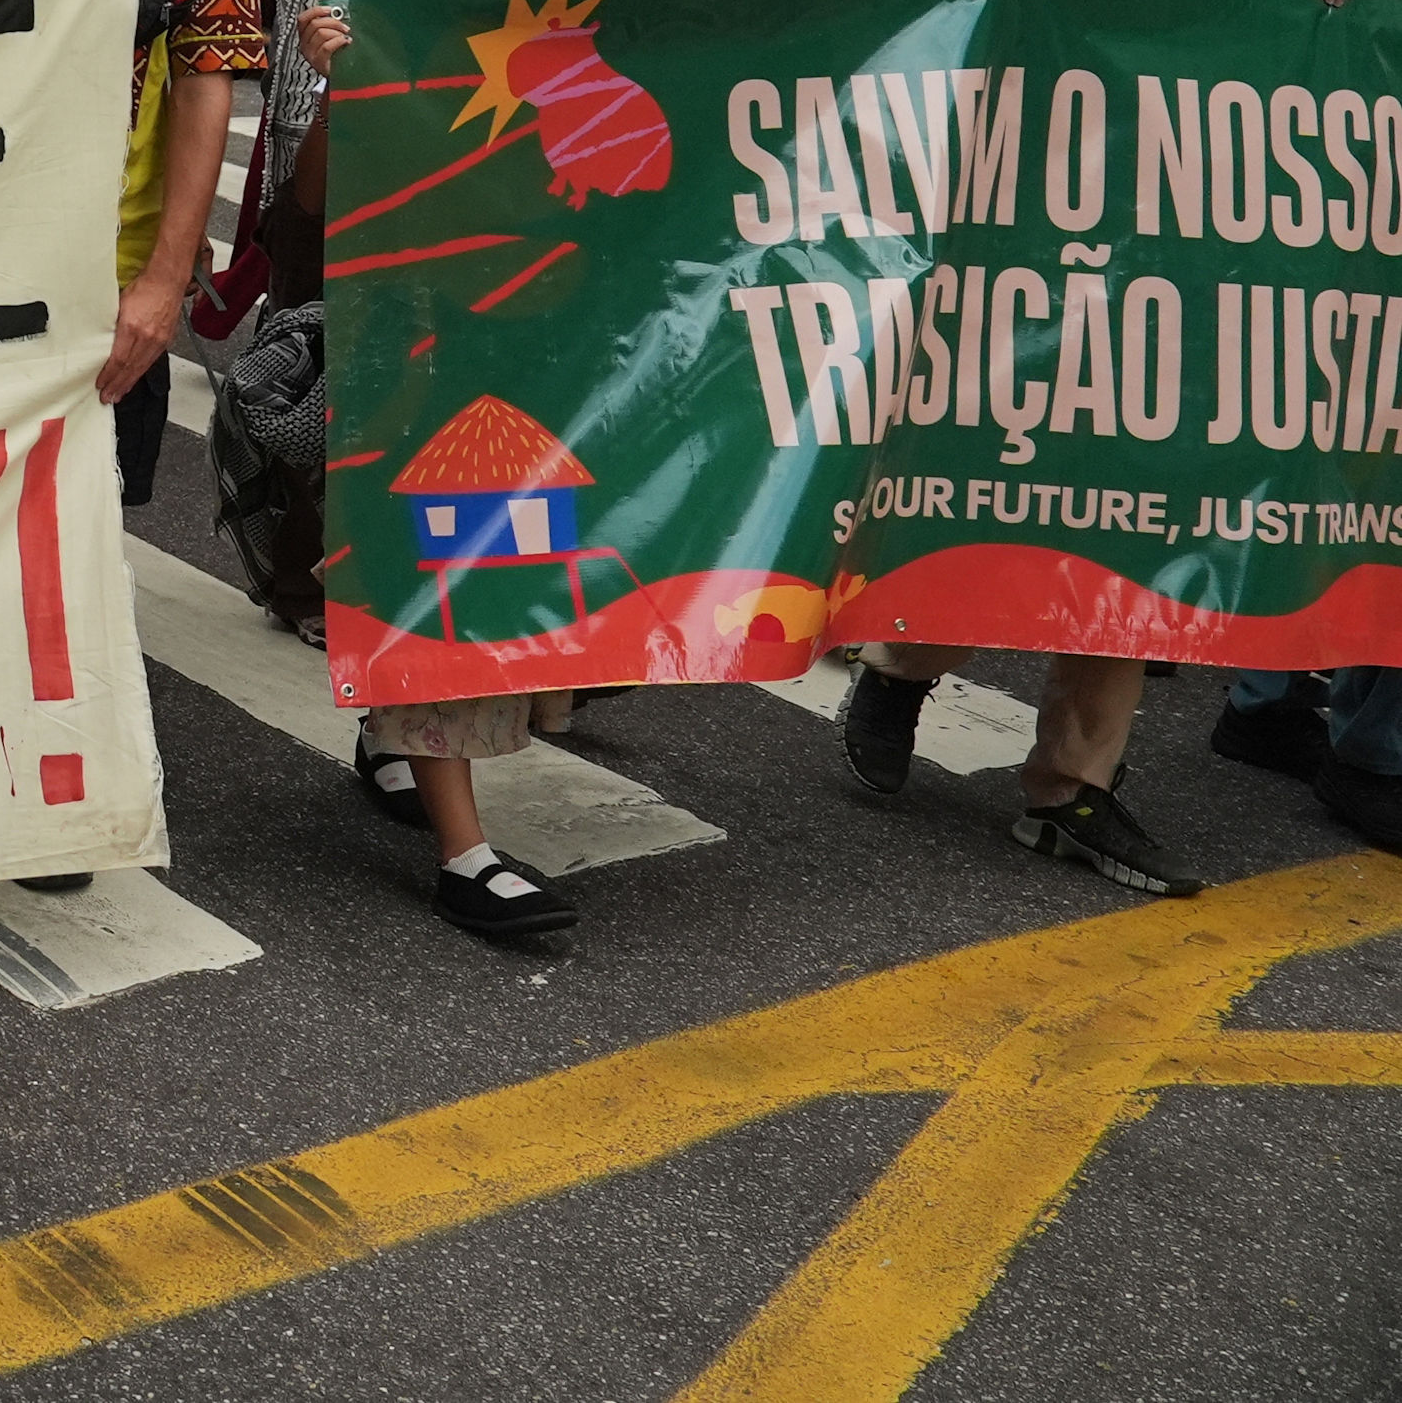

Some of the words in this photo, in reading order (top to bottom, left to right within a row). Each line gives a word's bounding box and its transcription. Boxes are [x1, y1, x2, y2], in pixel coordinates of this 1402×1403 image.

[1045, 68, 1106, 232] O
[1136, 74, 1402, 256] NOSSO
[872, 476, 955, 520] OUR
[966, 478, 1180, 545] FUTURE,
[1192, 496, 1310, 545] JUST
